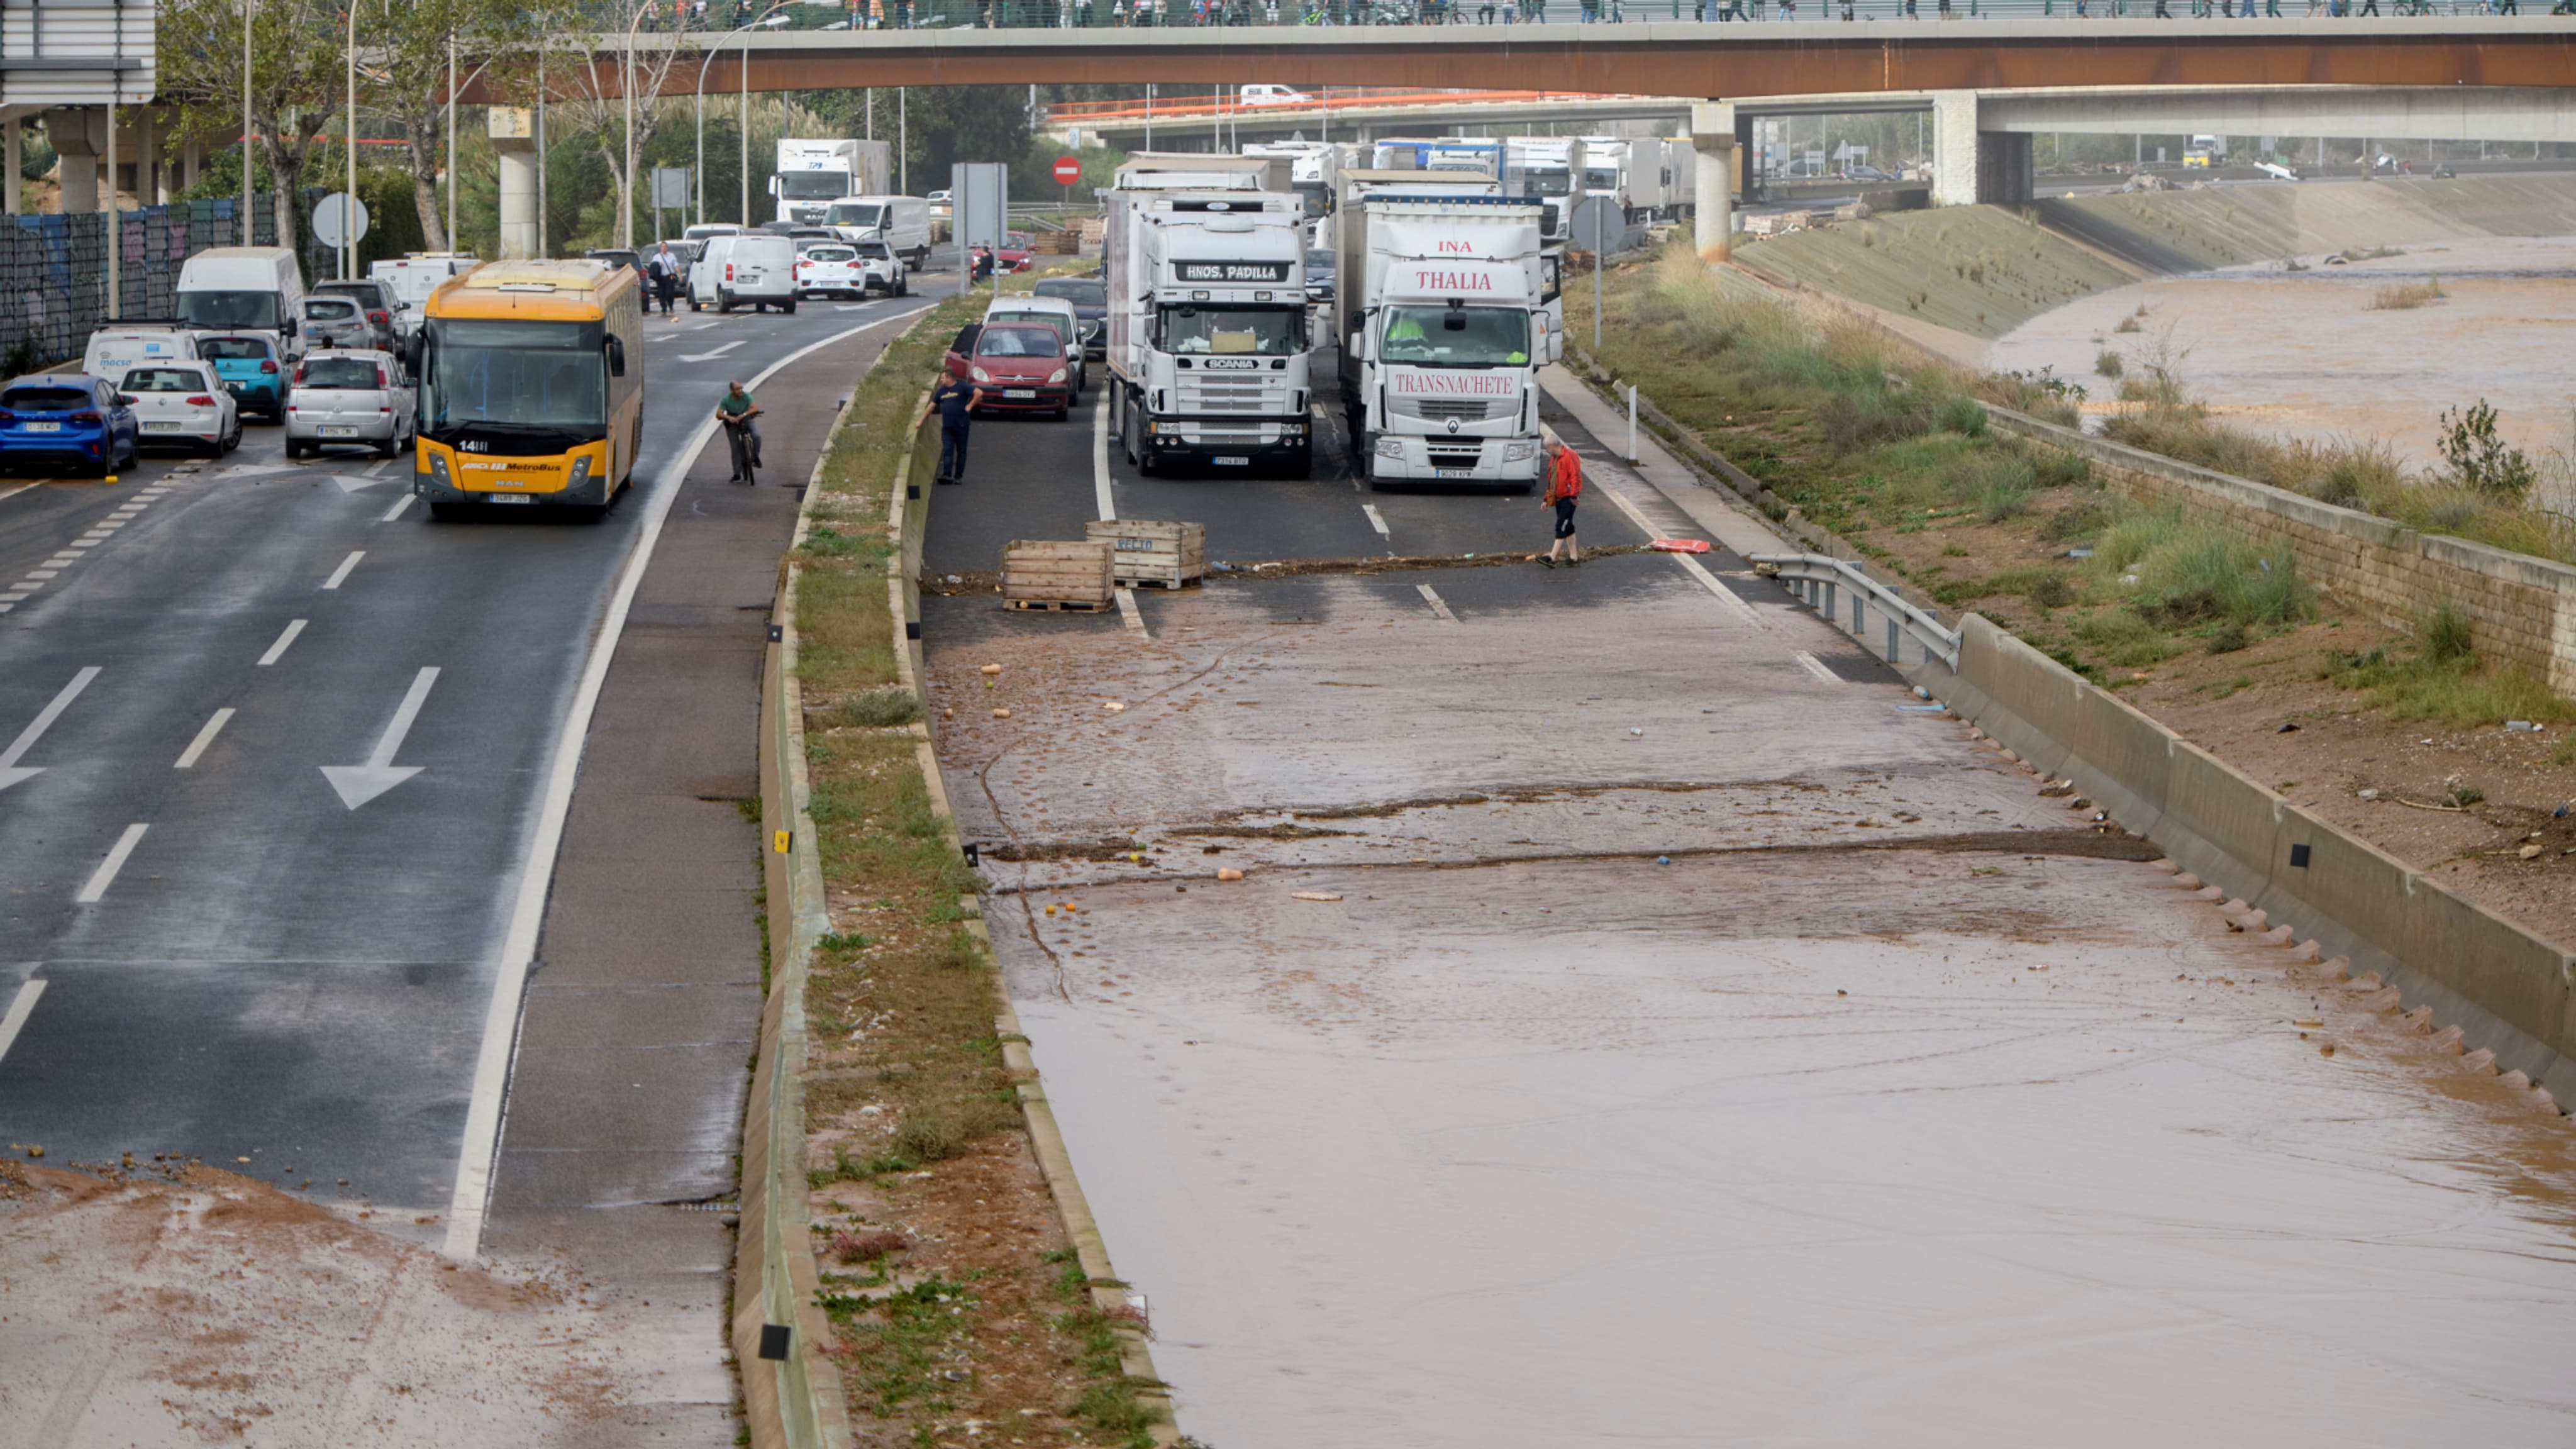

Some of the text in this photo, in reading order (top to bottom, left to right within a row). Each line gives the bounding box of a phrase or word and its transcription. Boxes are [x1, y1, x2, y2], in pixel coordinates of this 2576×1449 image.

[1439, 242, 1472, 252] INA
[1187, 265, 1277, 280] HNOS. PADILLA
[1416, 272, 1491, 290] THALIA
[1209, 360, 1254, 368] SCANIA
[1396, 374, 1513, 394] TRANSNACHETE
